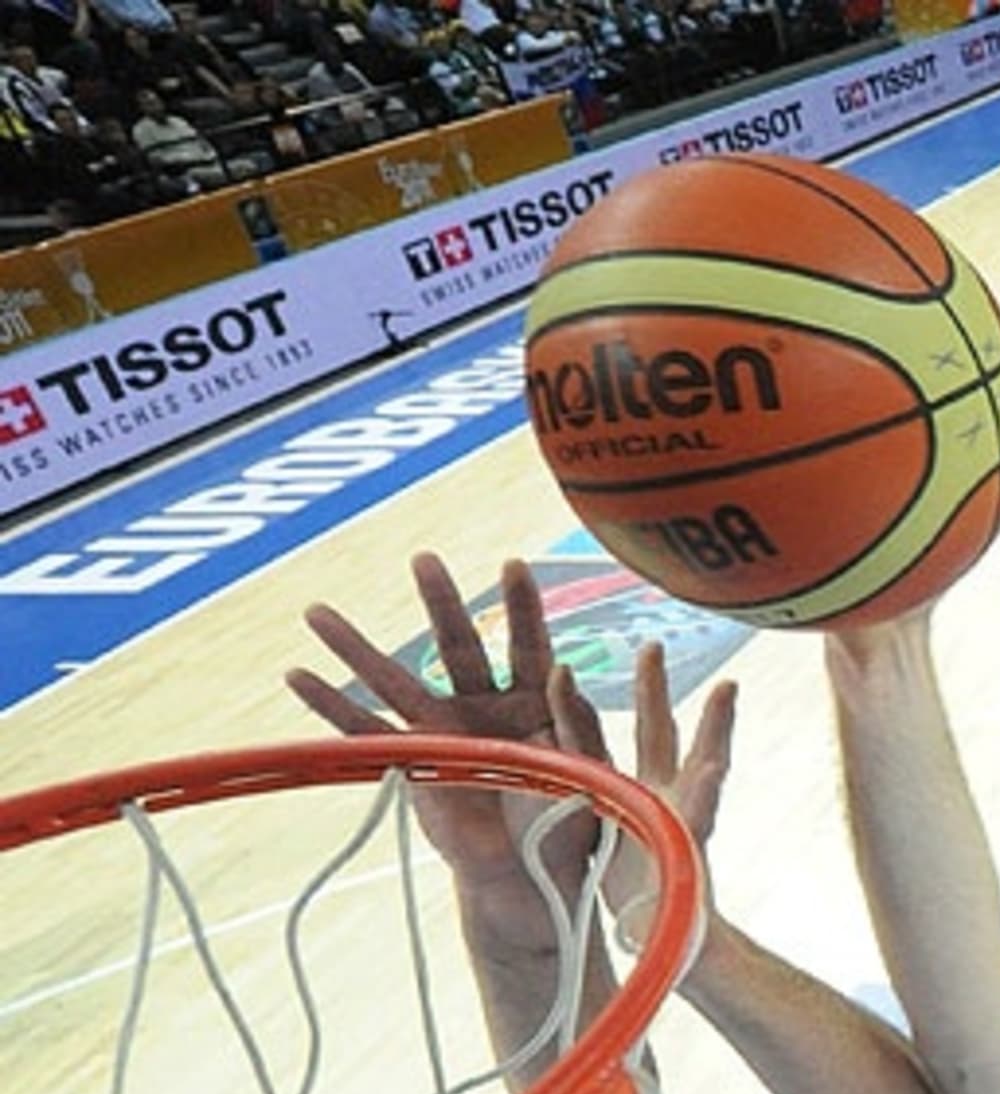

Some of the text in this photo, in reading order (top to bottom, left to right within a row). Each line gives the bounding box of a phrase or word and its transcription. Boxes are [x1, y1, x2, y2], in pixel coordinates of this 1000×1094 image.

[866, 54, 938, 101] TISSOT
[703, 103, 804, 155] TISSOT
[468, 170, 614, 252] TISSOT
[36, 290, 287, 416] TISSOT
[0, 448, 49, 482] ISS
[58, 393, 182, 457] WATCHES
[189, 361, 260, 404] SINCE
[557, 428, 721, 464] OFFICIAL
